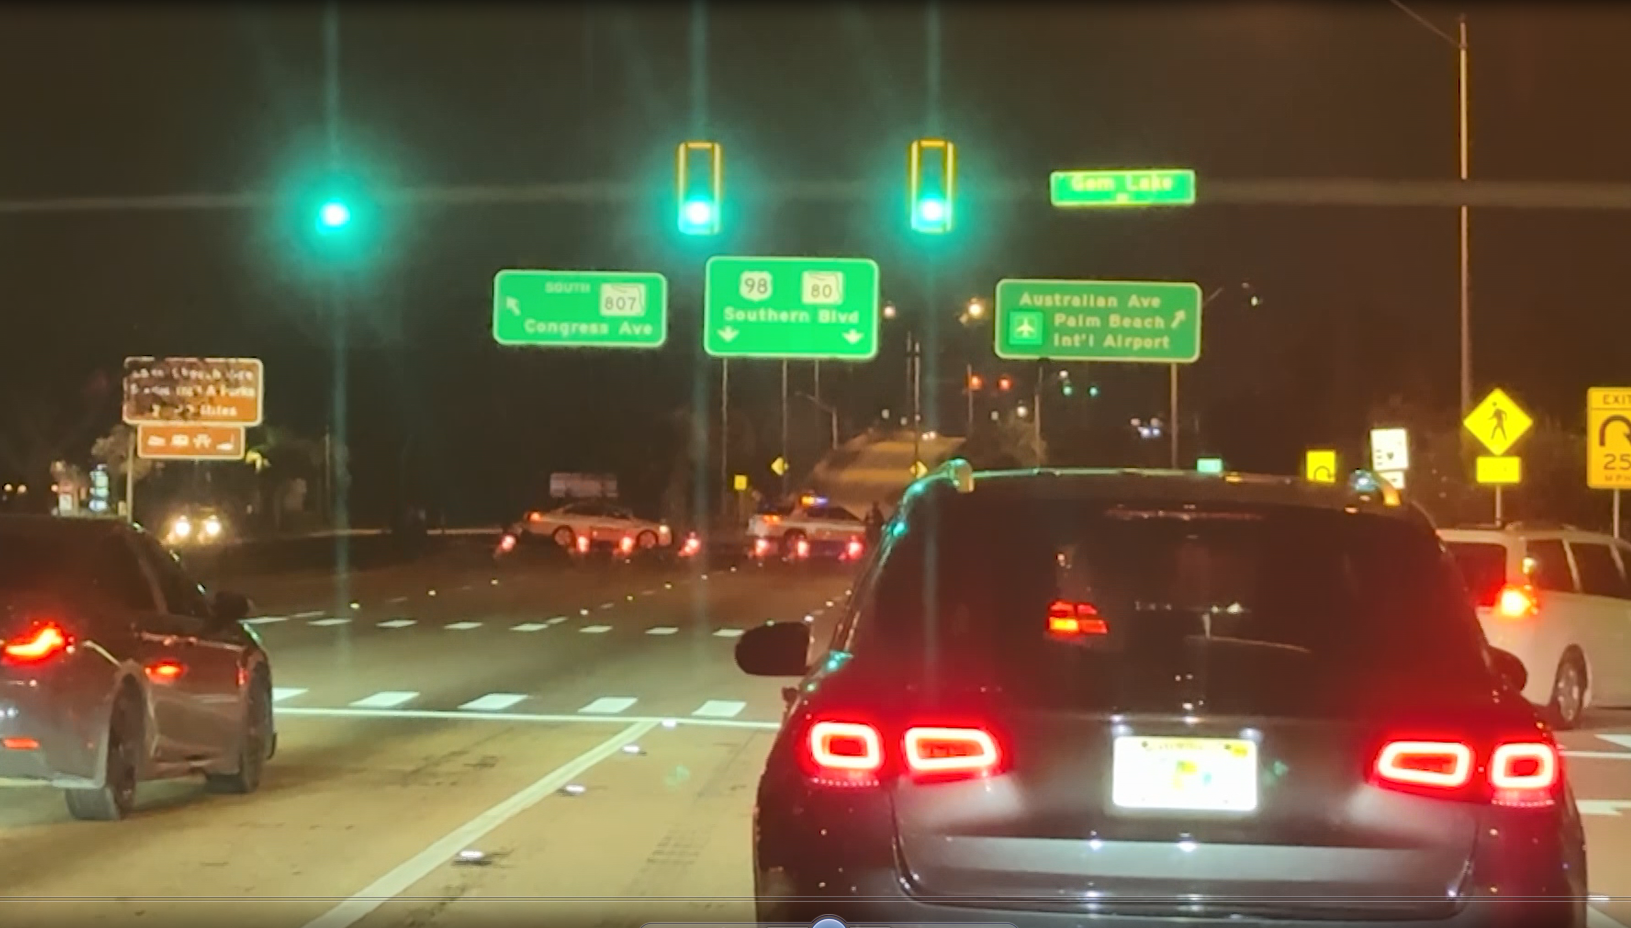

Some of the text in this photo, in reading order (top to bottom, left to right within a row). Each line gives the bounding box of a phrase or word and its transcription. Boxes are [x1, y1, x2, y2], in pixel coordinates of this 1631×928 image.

[544, 281, 591, 294] SOUTH
[744, 277, 768, 295] 98
[810, 284, 833, 299] 80
[604, 296, 638, 311] 807
[1018, 291, 1161, 309] Australian Ave
[723, 305, 860, 324] Southern Blvd
[1053, 312, 1165, 329] Palm Beach
[523, 318, 653, 338] Congress Ave
[1053, 332, 1171, 351] Int'l Airport
[1603, 453, 1631, 471] 25
